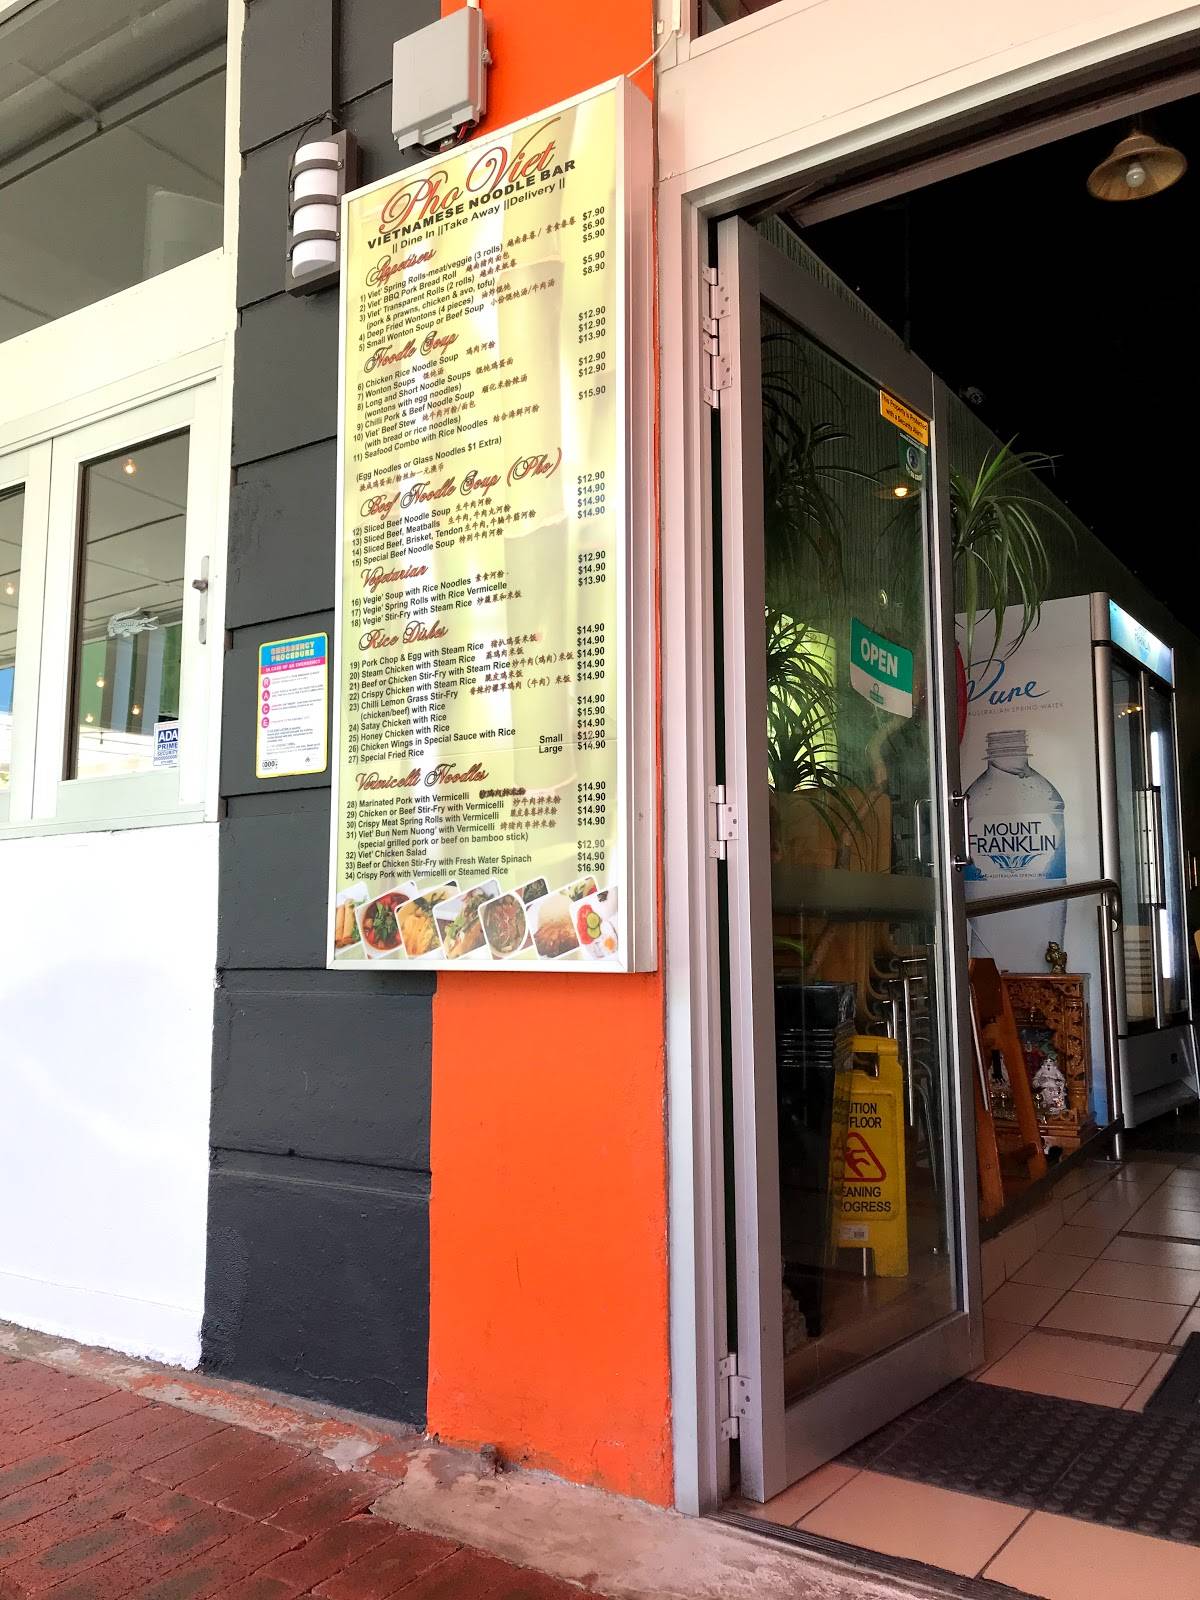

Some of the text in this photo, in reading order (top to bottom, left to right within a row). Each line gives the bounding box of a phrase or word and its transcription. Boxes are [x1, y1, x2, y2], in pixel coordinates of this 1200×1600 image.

[378, 116, 561, 234] Pho Viet
[367, 159, 575, 249] VIETNAMESE NOODLE BAR
[582, 206, 604, 221] $7.90
[400, 235, 421, 248] Dine
[425, 230, 434, 239] In
[470, 204, 500, 221] Away
[582, 216, 604, 232] $6.90
[582, 228, 605, 243] $5.90
[582, 250, 605, 265] $5.90
[582, 261, 605, 276] $8.90
[578, 305, 605, 321] $12.90
[358, 342, 365, 351] 5)
[366, 335, 385, 348] Small
[386, 327, 414, 341] Wonton
[415, 320, 434, 331] Soup
[445, 308, 462, 321] Beef
[464, 303, 484, 315] Soup
[578, 316, 606, 333] $12.90
[578, 328, 606, 344] $13.90
[363, 330, 459, 373] Noodle Soup
[578, 350, 606, 366] $12.90
[357, 353, 458, 391] 6) Chicken Rice Noodle Soup
[578, 362, 605, 378] $12.90
[578, 384, 606, 400] $15.90
[373, 463, 401, 476] Noodles
[403, 460, 411, 468] or
[412, 455, 433, 465] Glass
[434, 446, 465, 460] Noodles
[467, 442, 476, 452] $1
[577, 470, 604, 484] $12.90
[359, 491, 401, 520] Beef
[399, 476, 456, 508] Noodle
[459, 469, 501, 497] Soup
[577, 482, 605, 496] $14.90
[577, 493, 605, 508] $14.90
[577, 505, 605, 519] $14.90
[352, 507, 450, 536] 12) Sliced Beef Noodle Soup
[351, 539, 455, 567] 15) Special Beef Noodle Soup
[577, 550, 605, 564] $12.90
[577, 561, 606, 575] $14.90
[360, 564, 428, 593] Vegetarian
[577, 573, 606, 587] $13.90
[576, 622, 604, 636] $14.90
[358, 628, 399, 651] Rice
[576, 634, 604, 647] $14.90
[576, 646, 604, 659] $14.90
[861, 638, 898, 678] OPEN
[349, 654, 475, 680] 20) Steam Chicken with Steam Rice
[576, 658, 604, 671] $14.90
[576, 669, 605, 682] $14.90
[576, 693, 605, 705] $14.90
[576, 705, 605, 717] $15.90
[348, 713, 446, 732] 24) Satay Chicken with Rice
[577, 717, 605, 729] $14.90
[539, 732, 562, 744] Small
[576, 729, 605, 741] $12.90
[538, 744, 563, 754] Large
[576, 739, 606, 751] $14.90
[354, 762, 489, 791] Vermicelli Noodles
[577, 780, 606, 793] $14.90
[346, 791, 469, 809] 28) Marinated Pork with Vermicelli
[577, 791, 606, 804] $14.90
[577, 804, 606, 815] $14.90
[577, 816, 605, 826] $14.90
[984, 822, 1042, 836] MOUNT
[577, 839, 605, 849] $12.90
[577, 851, 604, 861] $14.90
[344, 871, 355, 880] 34)
[356, 871, 378, 880] Crispy
[379, 870, 395, 878] Pork
[396, 869, 411, 878] with
[412, 868, 447, 877] Vermicelli
[457, 866, 490, 875] Steamed
[491, 866, 508, 874] Rice
[577, 862, 605, 872] $16.90
[850, 1117, 881, 1128] FLOOR
[842, 1186, 881, 1197] EANING
[844, 1201, 891, 1212] OGRESS
